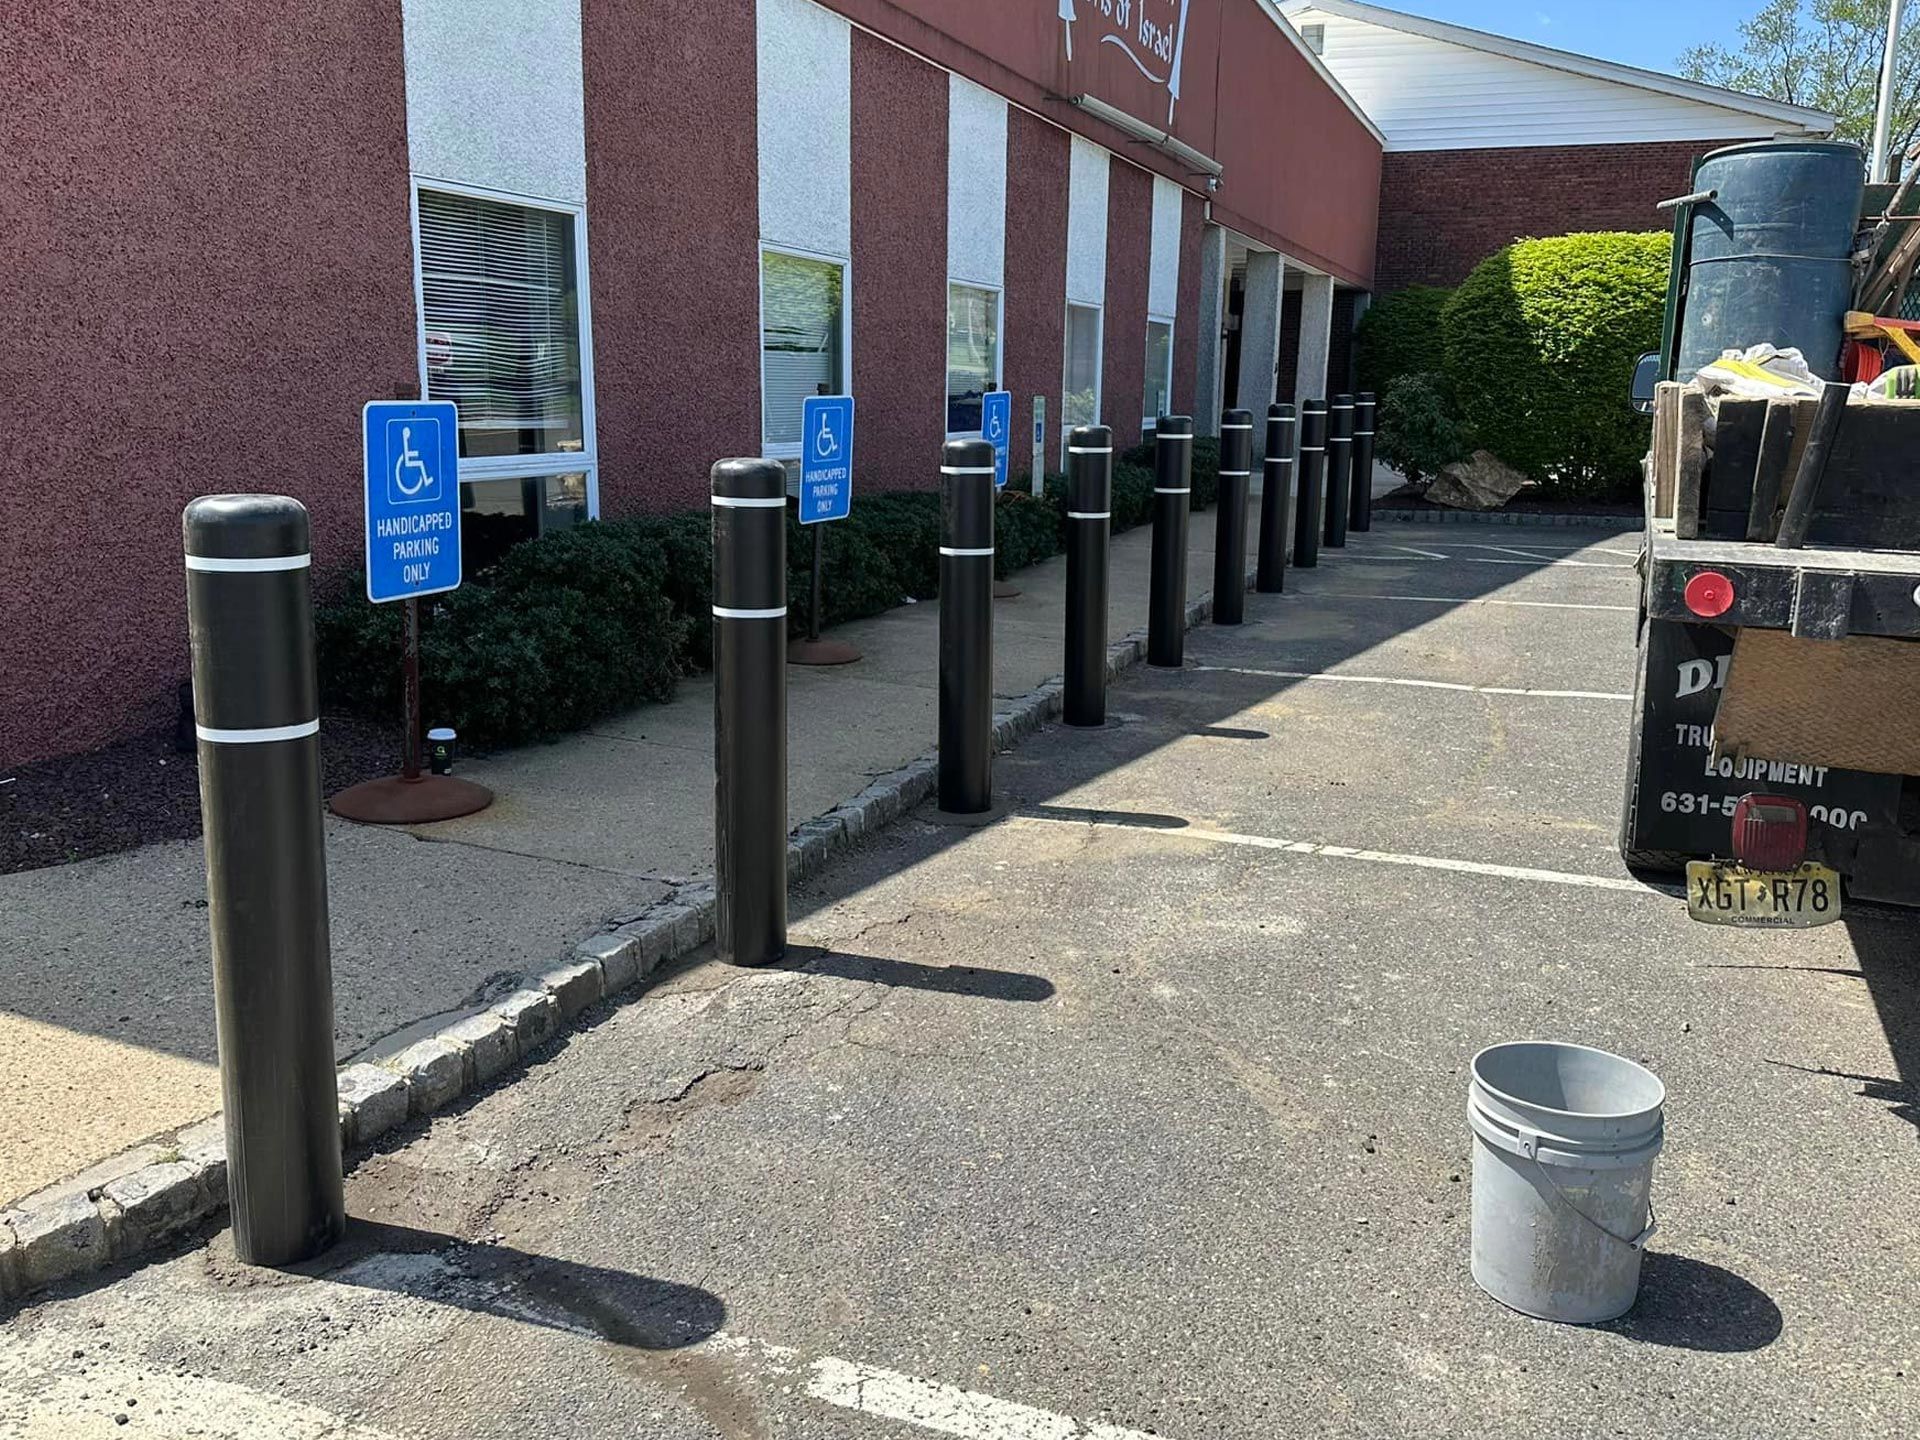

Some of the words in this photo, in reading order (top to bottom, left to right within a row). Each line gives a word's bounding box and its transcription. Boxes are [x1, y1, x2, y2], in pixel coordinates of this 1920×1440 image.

[1139, 0, 1173, 64] Israel
[805, 467, 847, 483] HANDICAPPED
[812, 483, 838, 498] PARKING
[817, 500, 832, 512] ONLY
[377, 512, 452, 537] HANDICAPPED
[393, 537, 439, 560] PARKING
[403, 562, 431, 583] ONLY
[1698, 876, 1750, 911] XGT
[1772, 878, 1829, 912] R78
[1731, 915, 1795, 925] COMMERCIAL
